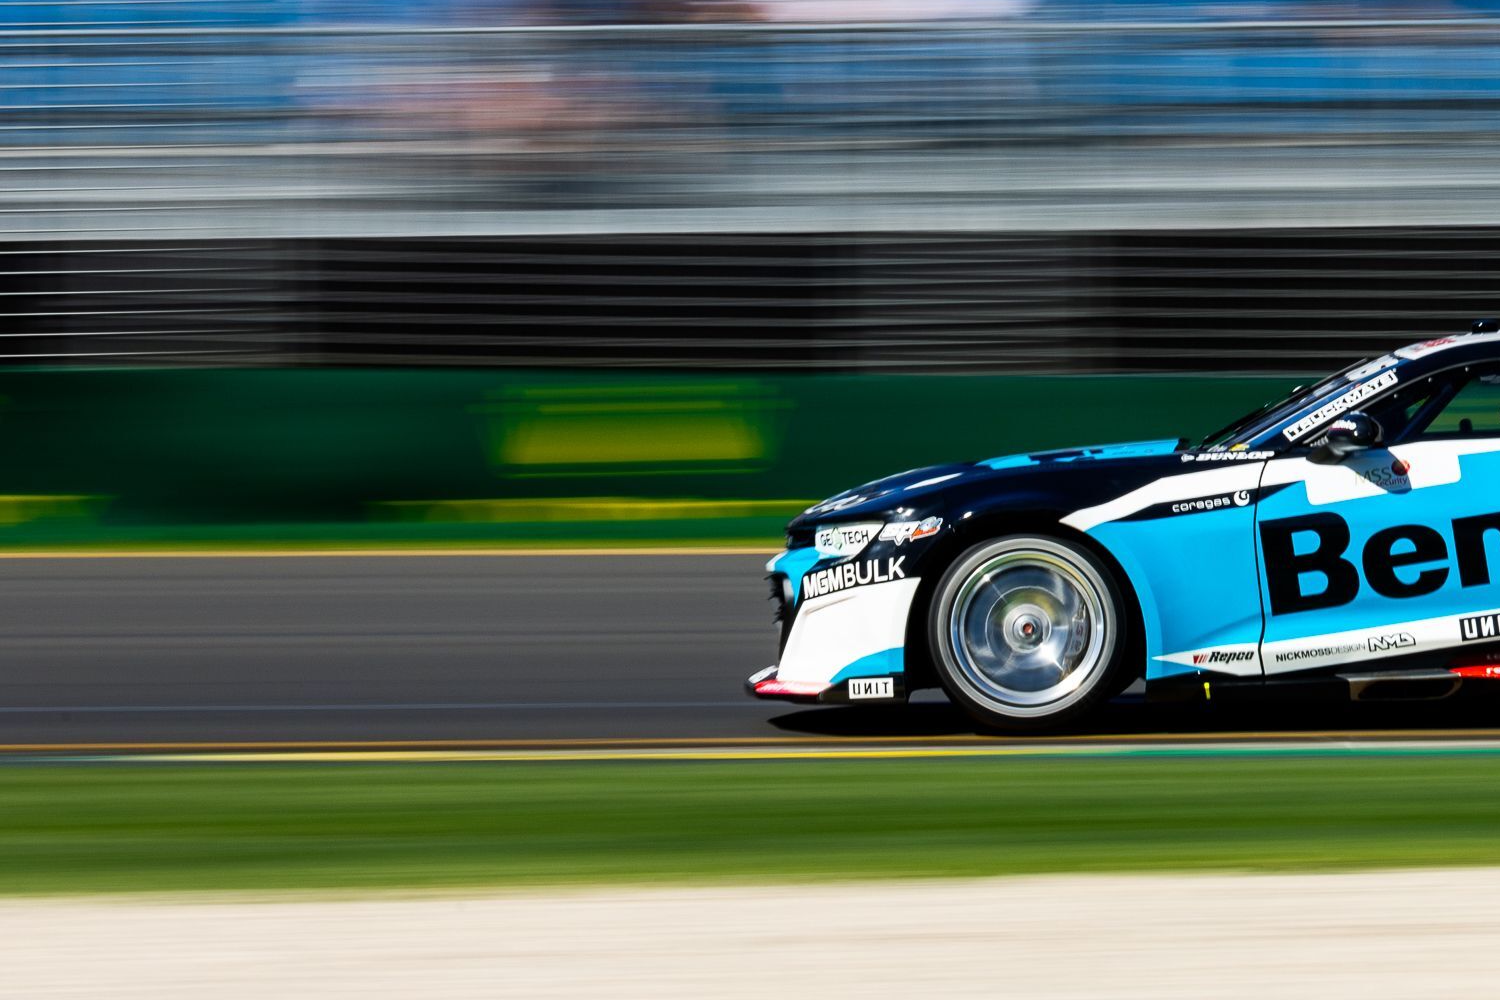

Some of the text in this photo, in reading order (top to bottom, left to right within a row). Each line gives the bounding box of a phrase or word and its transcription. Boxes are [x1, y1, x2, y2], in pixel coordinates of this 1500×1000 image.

[1195, 450, 1275, 461] DUNLOP
[802, 555, 906, 600] MGMBULK
[1208, 650, 1255, 665] Repco
[852, 682, 890, 696] UNIT
